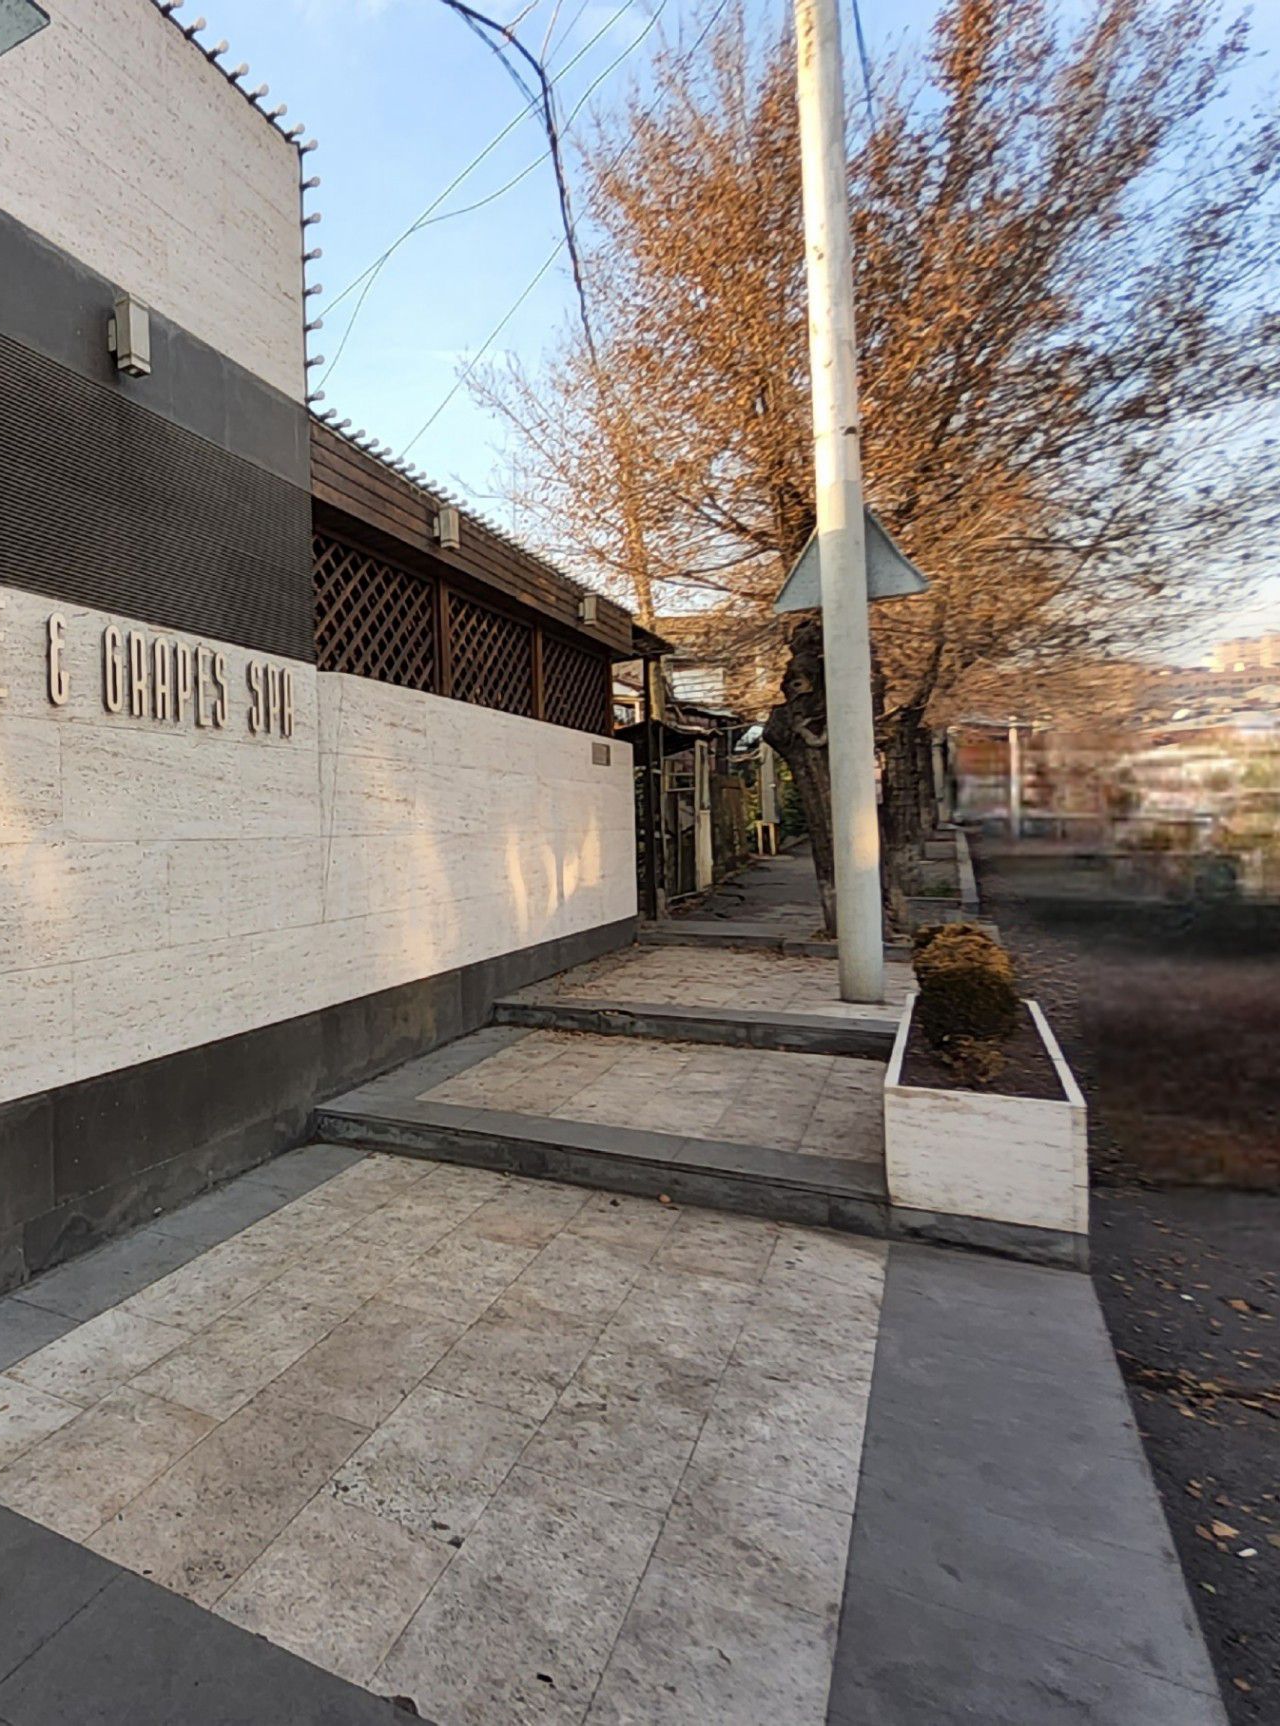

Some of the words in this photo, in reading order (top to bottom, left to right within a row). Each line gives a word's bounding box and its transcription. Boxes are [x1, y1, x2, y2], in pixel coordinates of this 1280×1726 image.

[47, 611, 69, 706] &
[103, 624, 228, 729] GRAPES
[249, 659, 294, 739] SPA
